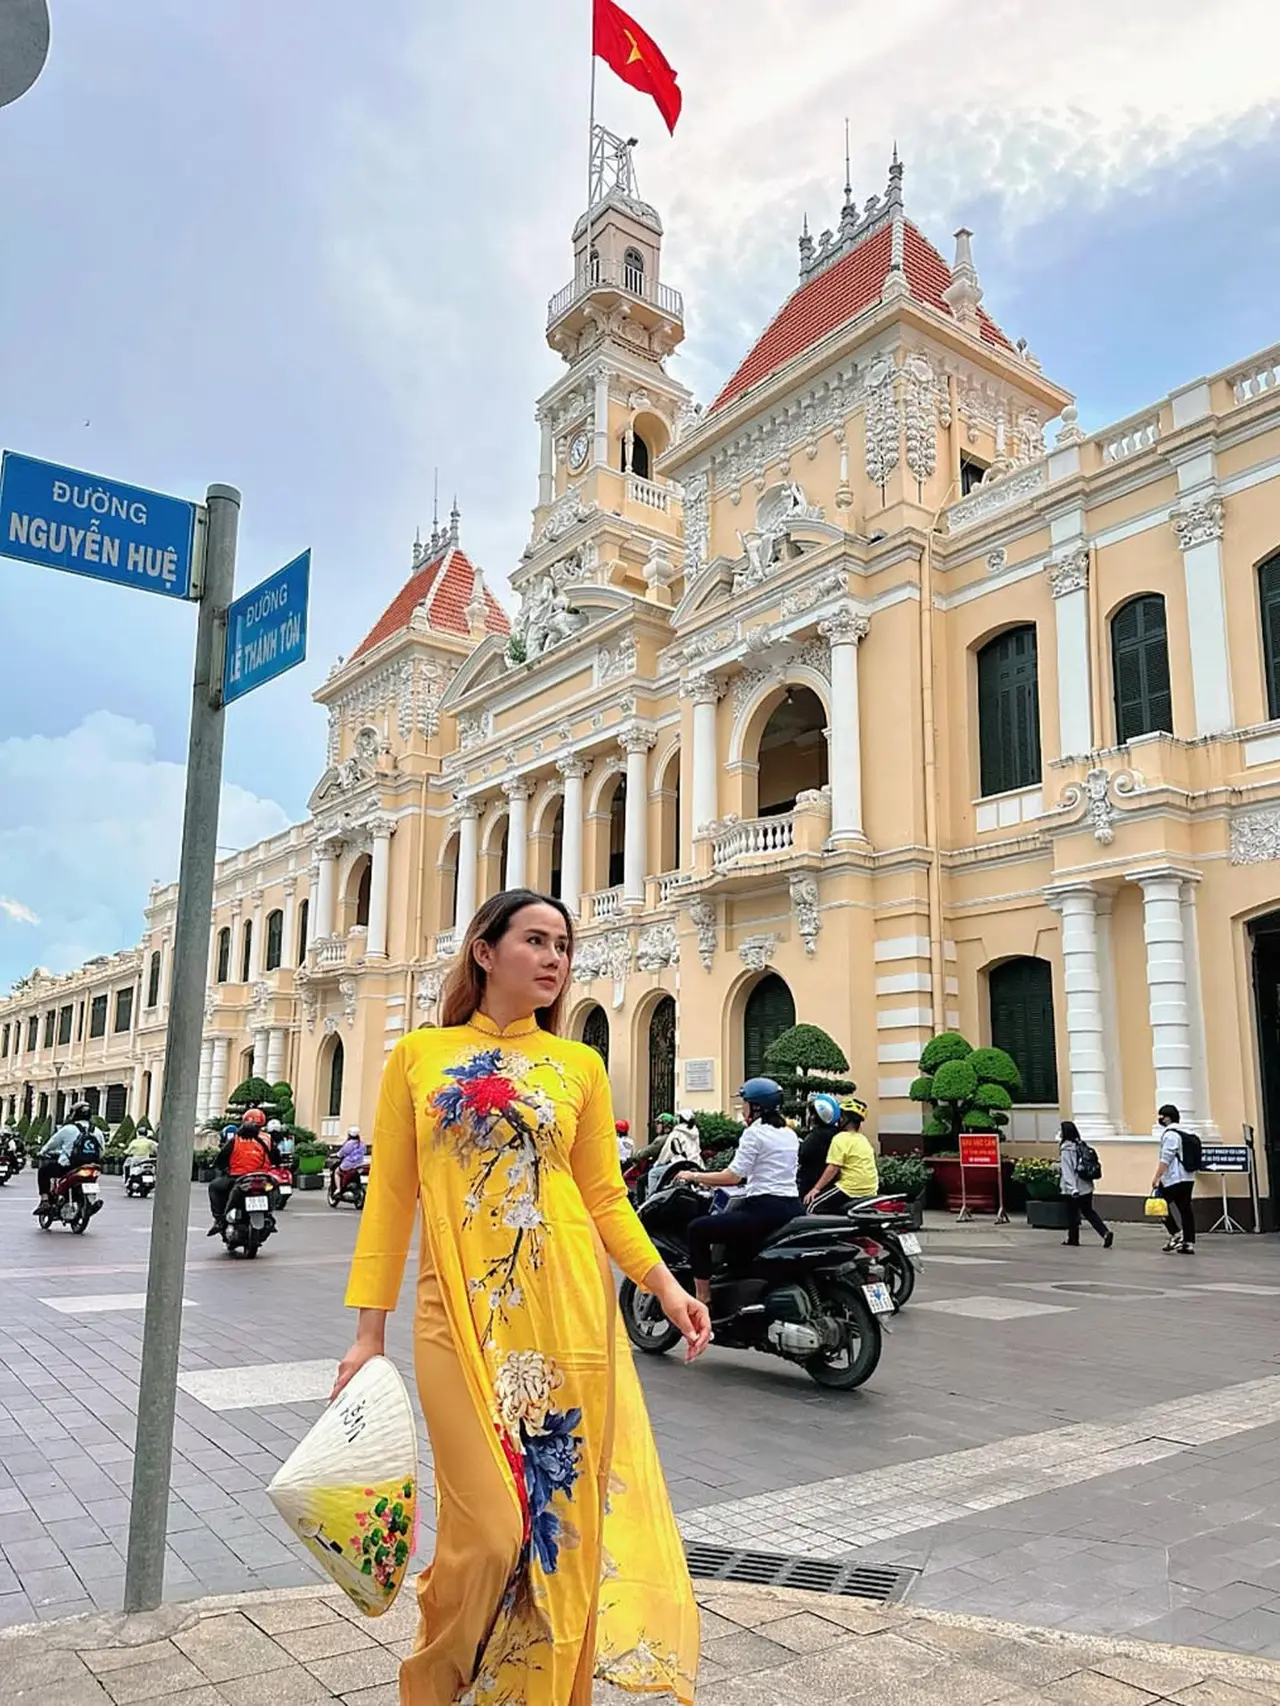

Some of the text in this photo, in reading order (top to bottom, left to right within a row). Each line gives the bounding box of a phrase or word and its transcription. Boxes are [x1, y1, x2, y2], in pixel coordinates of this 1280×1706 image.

[53, 481, 148, 526] ĐƯỜNG
[9, 512, 178, 589] NGUYỄN HUỆ
[246, 583, 288, 627] ĐƯỜNG
[229, 611, 301, 683] LÊ THÁNH TÔN
